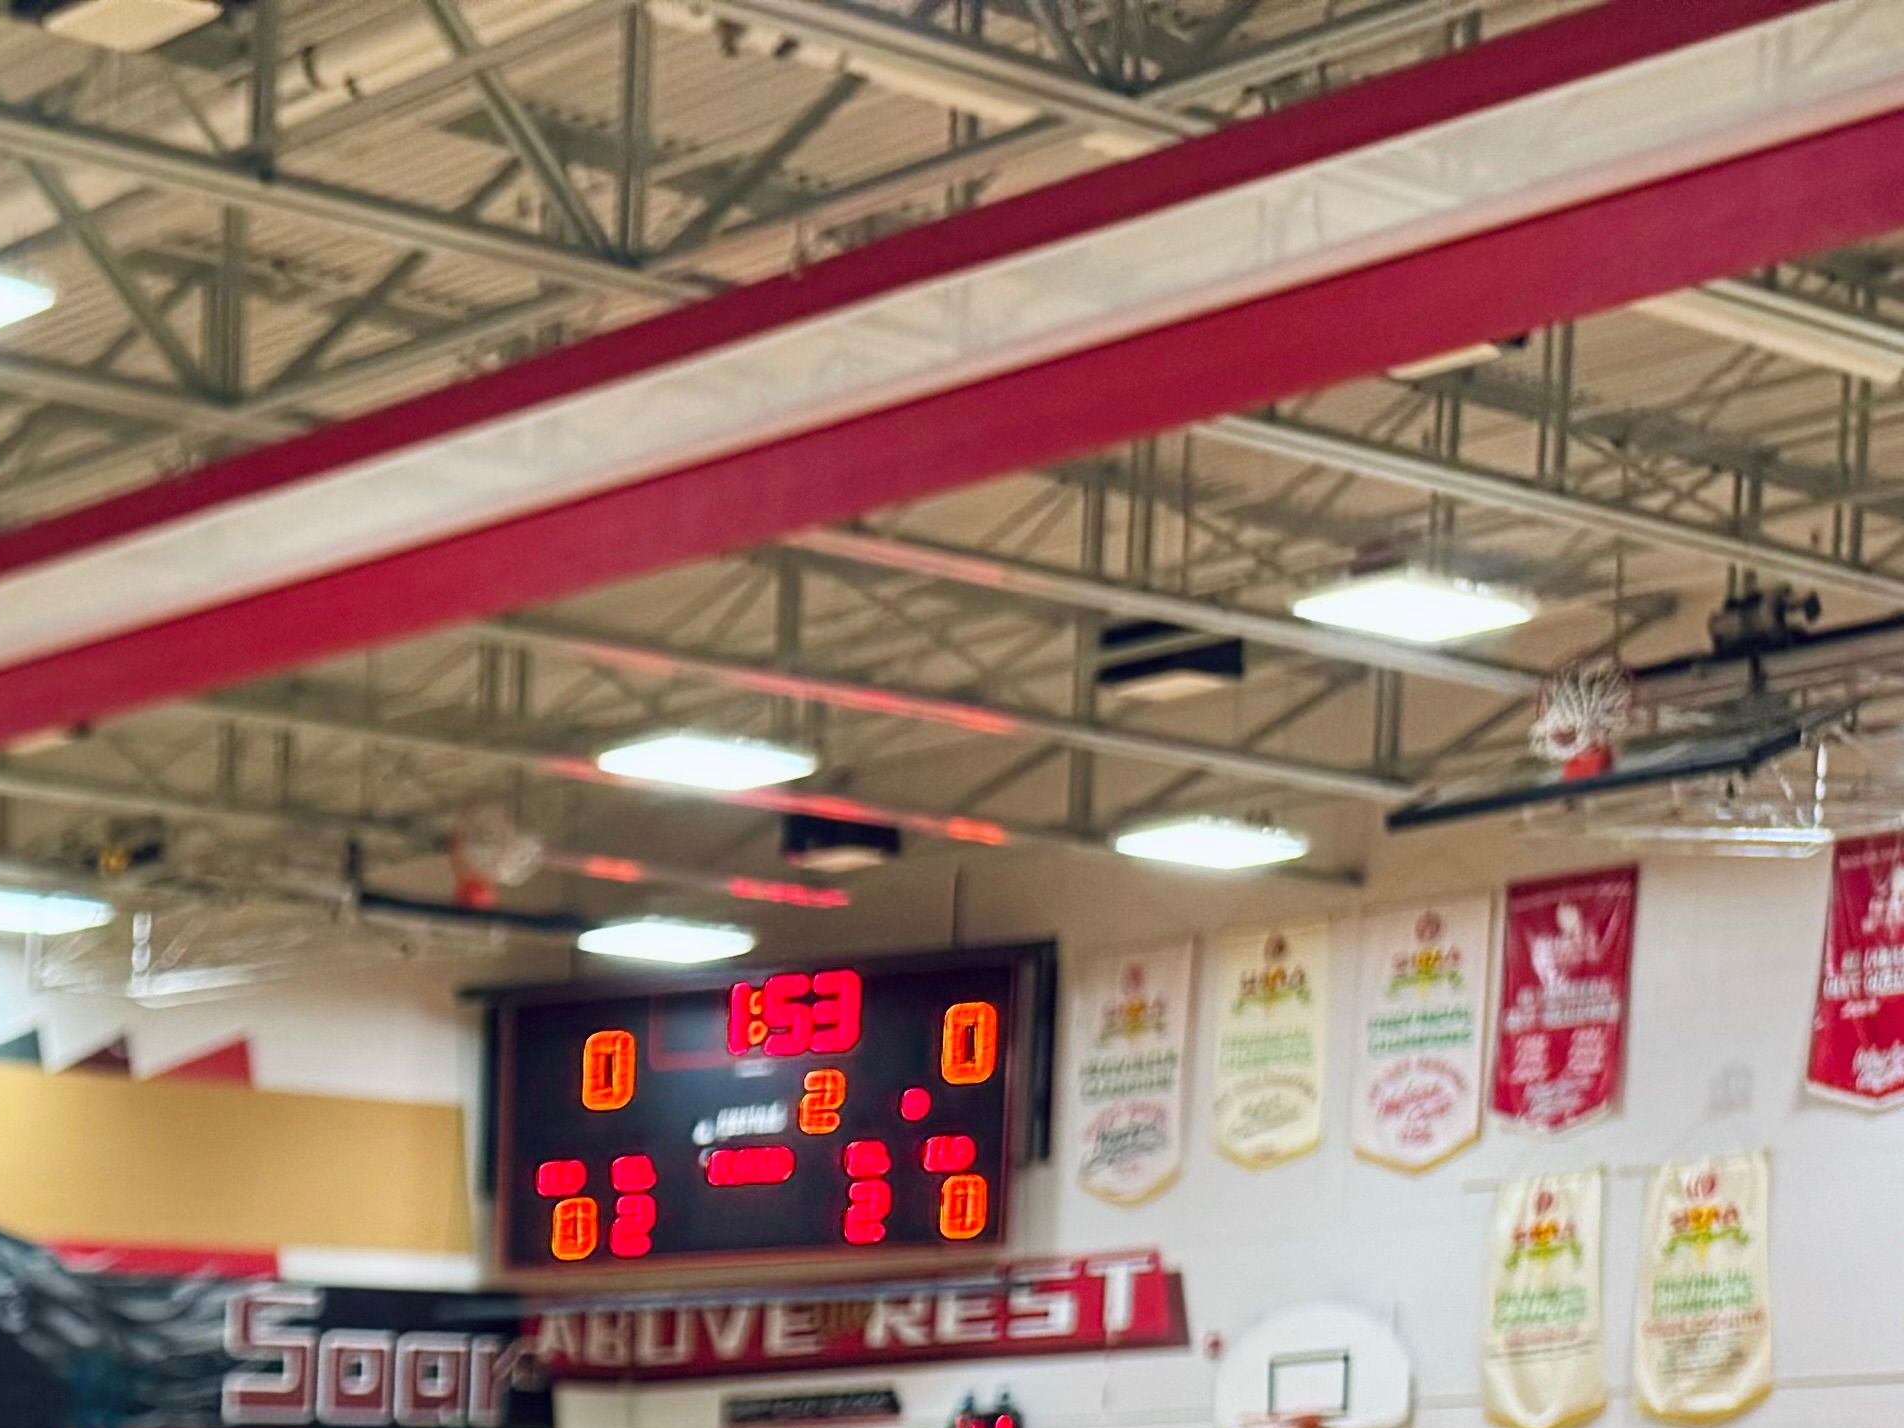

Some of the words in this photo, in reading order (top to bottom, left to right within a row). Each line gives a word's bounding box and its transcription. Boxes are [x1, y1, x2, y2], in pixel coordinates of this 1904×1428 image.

[727, 967, 863, 1057] 1:53
[941, 1001, 998, 1085] 0
[582, 1030, 636, 1112] 0
[799, 1068, 846, 1135] 2
[863, 1252, 1160, 1349] REST
